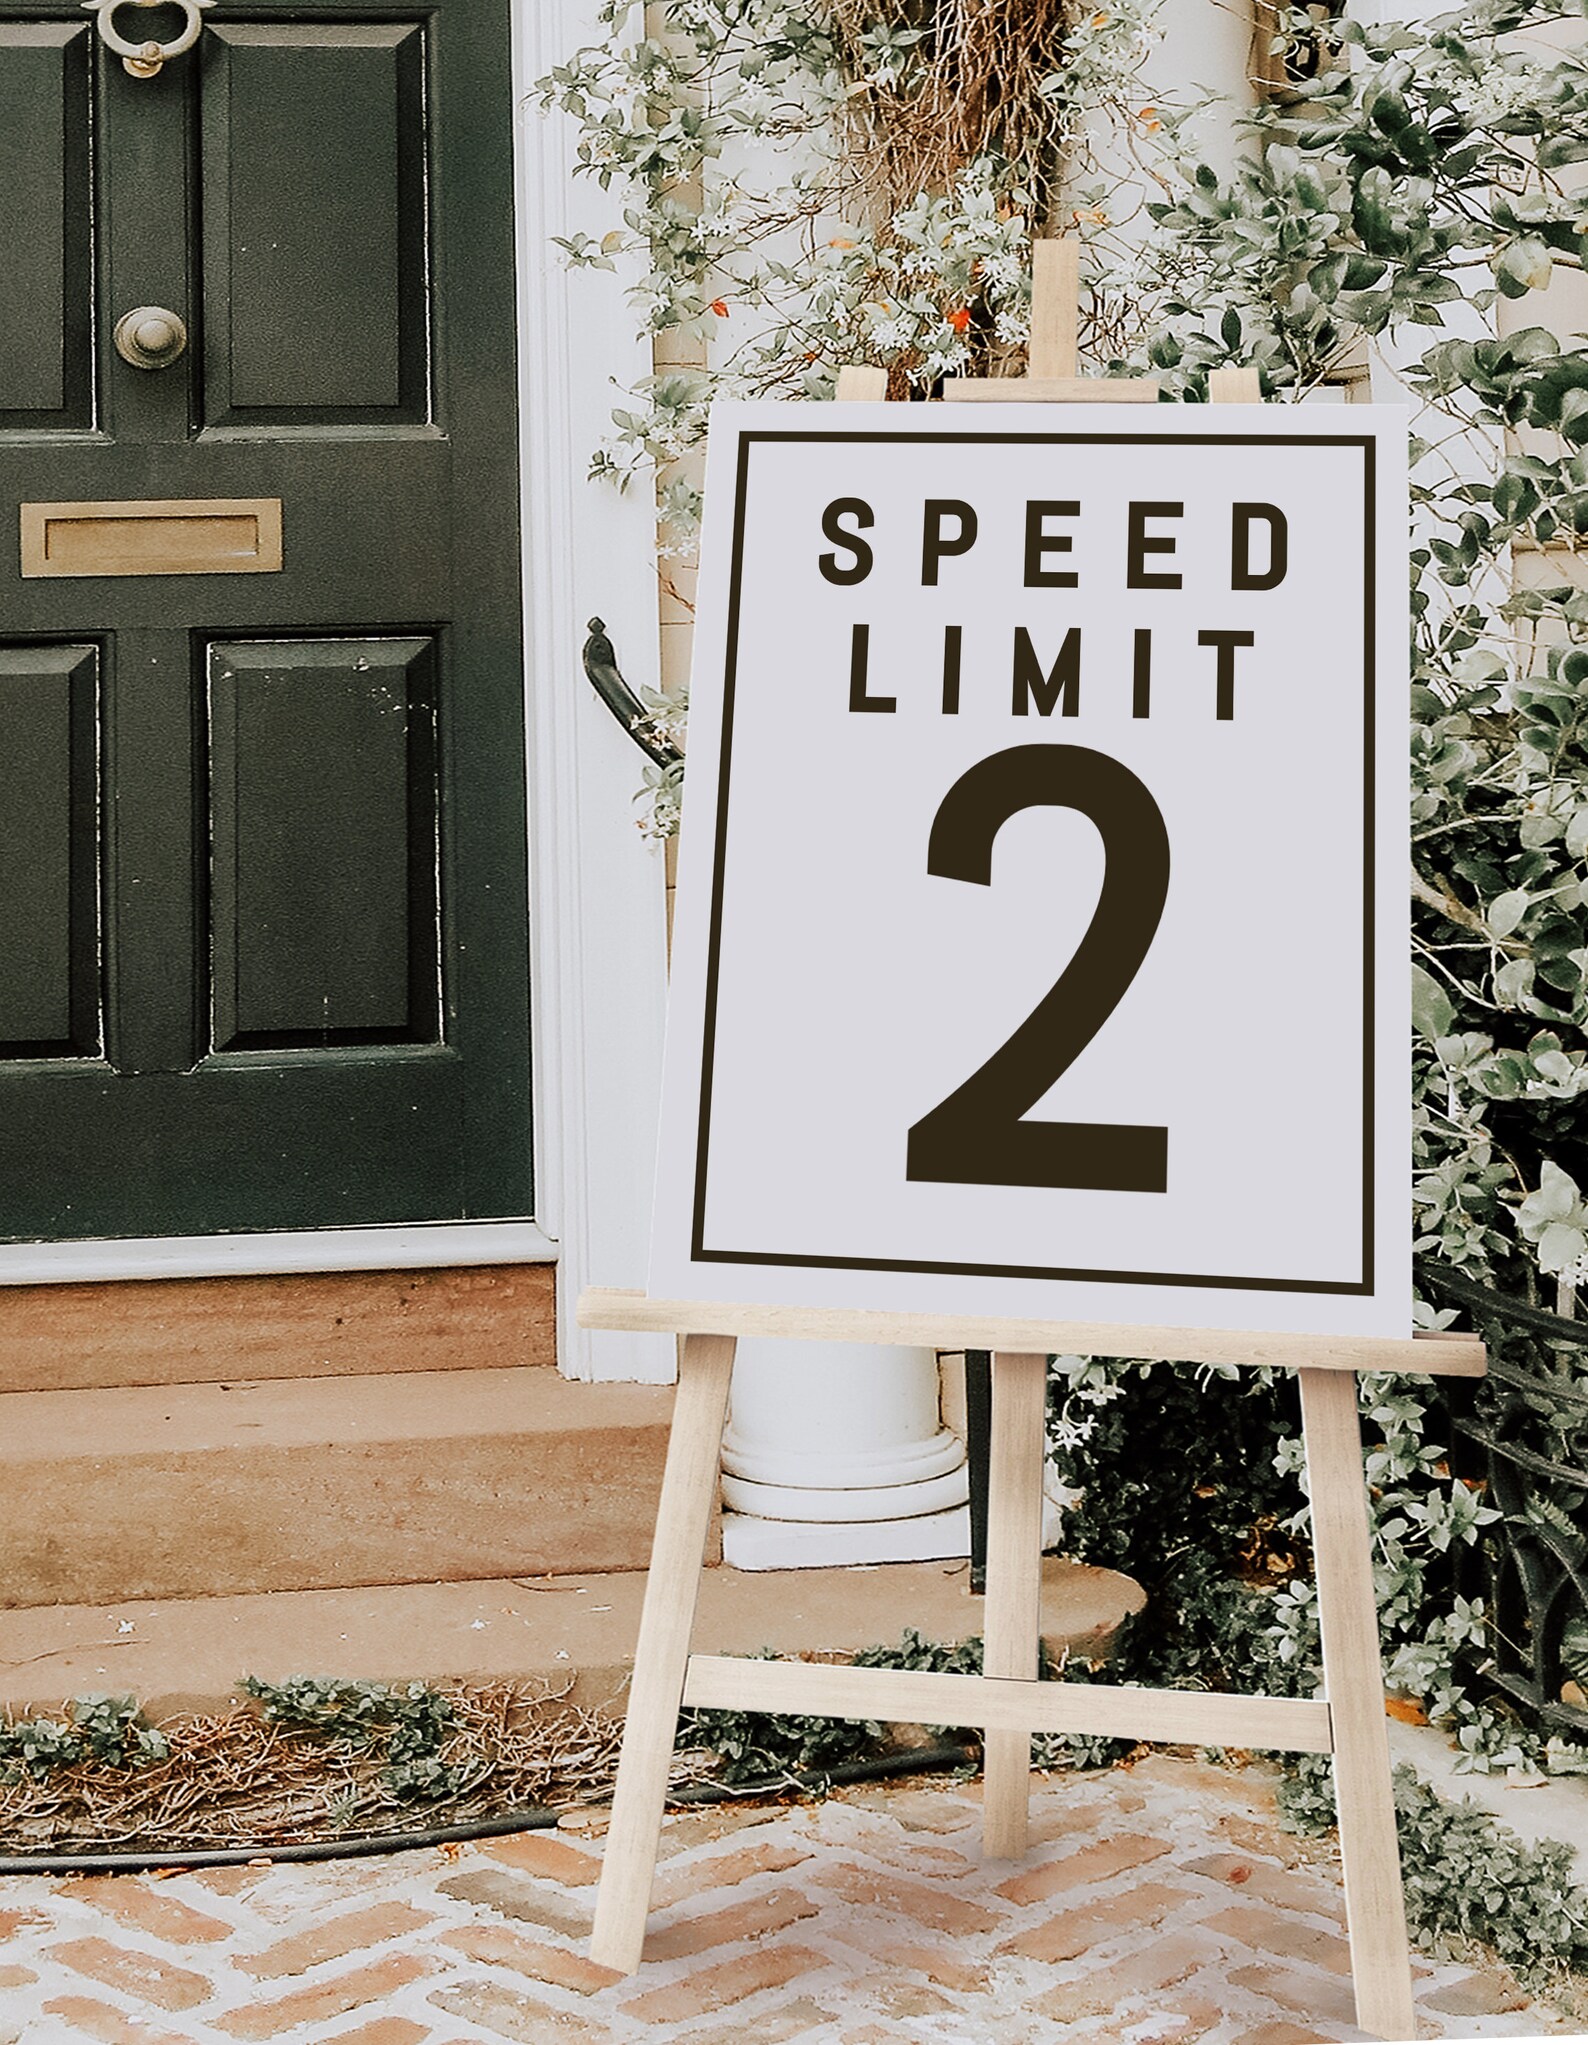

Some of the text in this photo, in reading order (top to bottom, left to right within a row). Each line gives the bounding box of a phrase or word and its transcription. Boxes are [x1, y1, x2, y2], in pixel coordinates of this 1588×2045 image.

[819, 498, 1288, 591] SPEED
[849, 624, 1255, 721] LIMIT
[906, 744, 1171, 1194] 2
